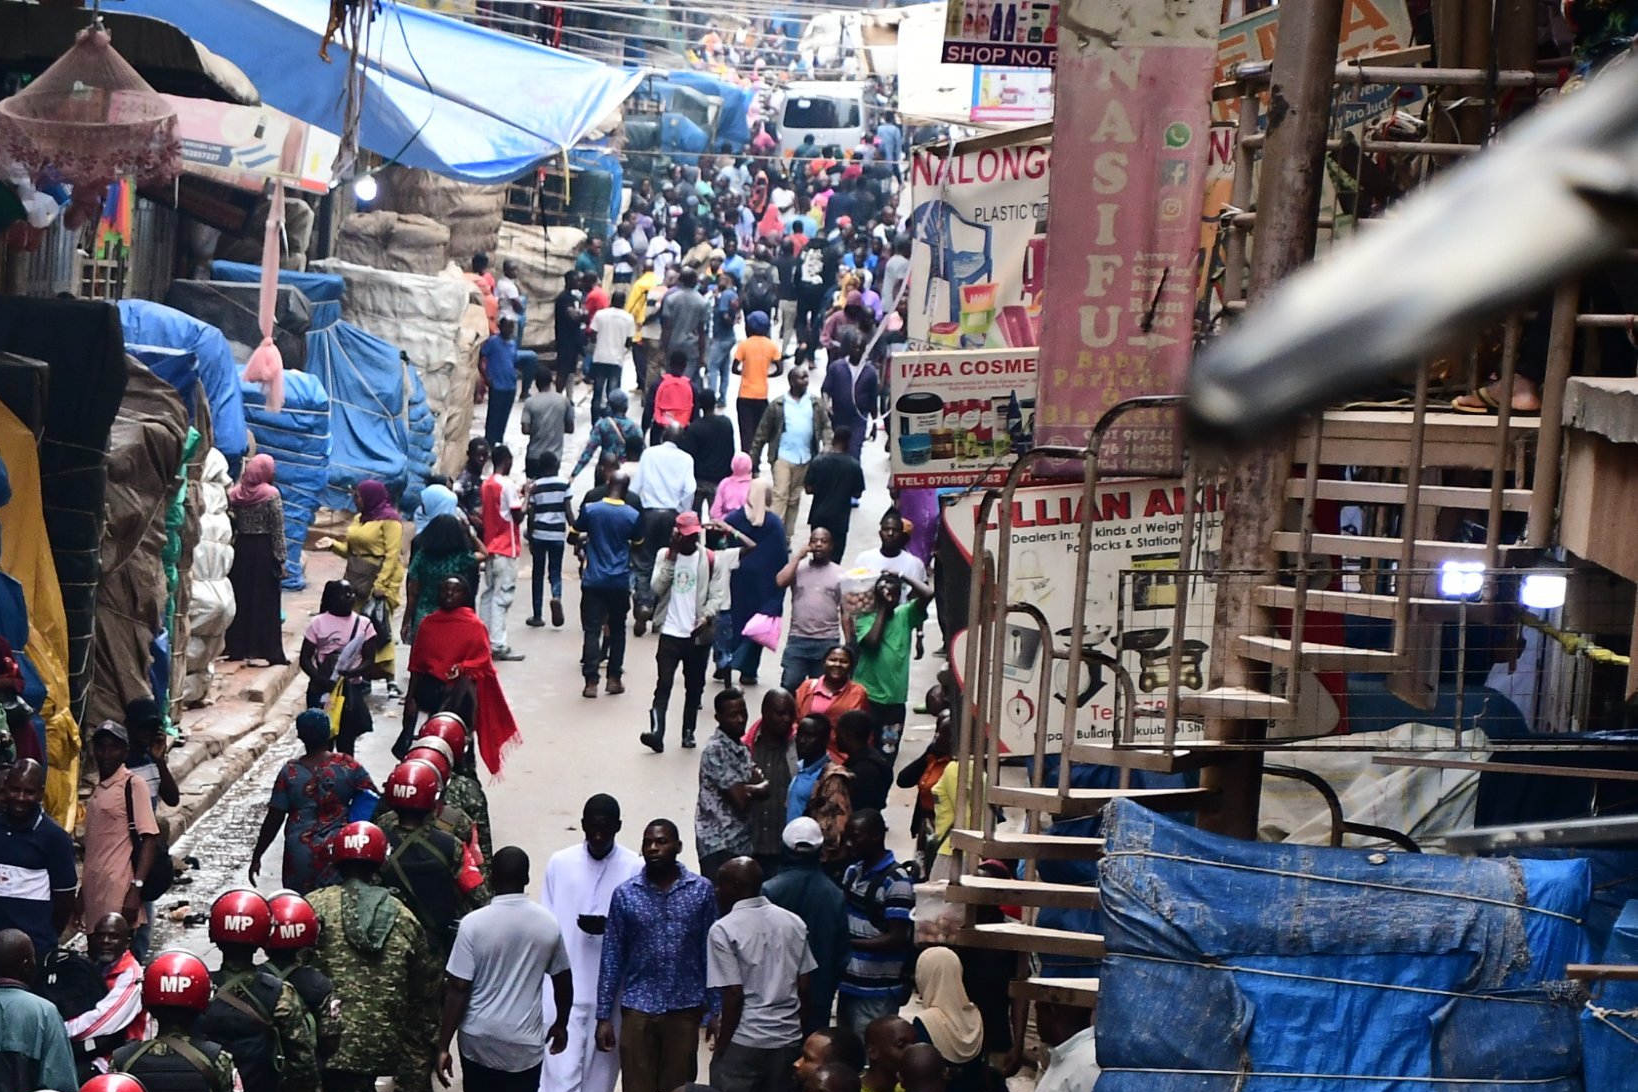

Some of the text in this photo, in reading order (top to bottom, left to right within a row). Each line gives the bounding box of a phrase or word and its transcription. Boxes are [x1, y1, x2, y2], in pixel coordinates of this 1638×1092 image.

[947, 45, 1006, 63] SHOP
[912, 144, 1052, 186] NALONG
[975, 203, 1028, 222] PLASTIC
[901, 361, 952, 378] IBRA
[897, 476, 925, 486] TEL:
[1012, 532, 1057, 544] Dealers
[1095, 525, 1127, 537] kinds
[1131, 523, 1142, 535] of
[1146, 520, 1202, 534] Weighg
[1125, 539, 1133, 549] &
[1091, 704, 1113, 721] Te
[1076, 728, 1121, 740] Buildin
[393, 783, 417, 800] MP
[344, 834, 370, 850] MP
[224, 914, 254, 931] MP
[280, 922, 306, 939] MP
[160, 976, 193, 993] MP
